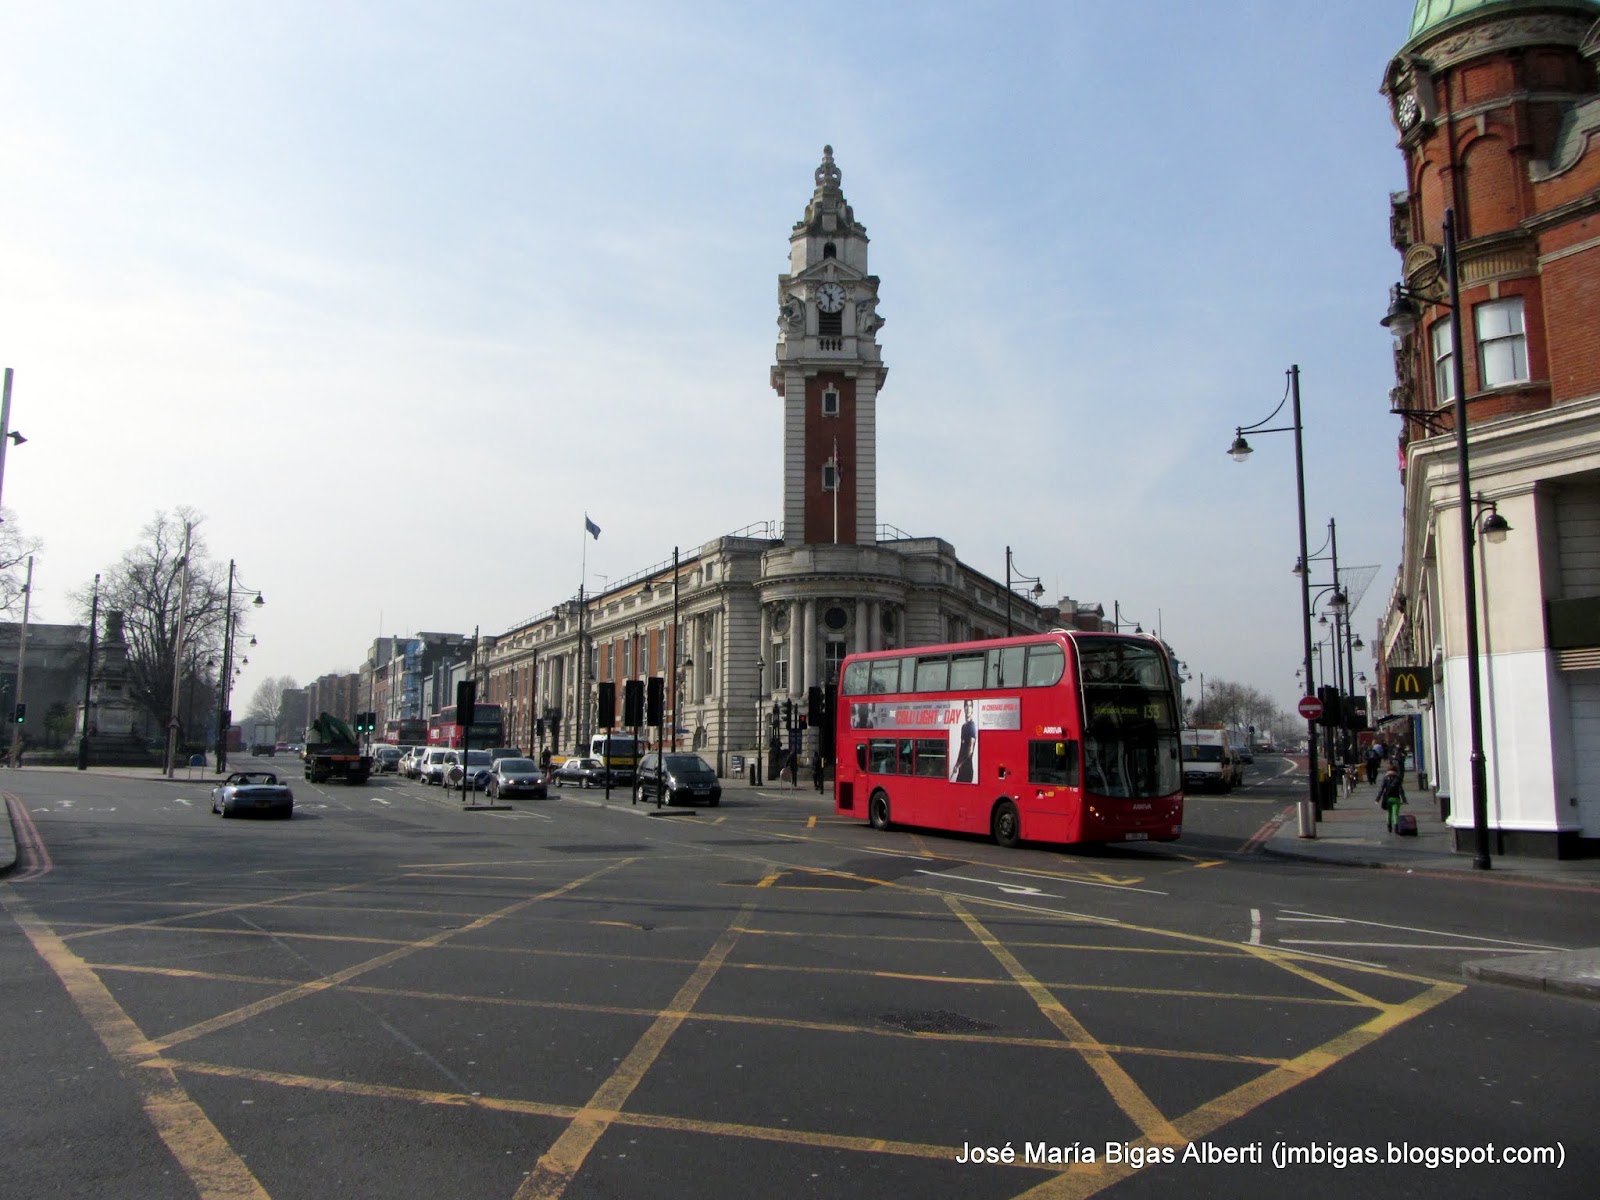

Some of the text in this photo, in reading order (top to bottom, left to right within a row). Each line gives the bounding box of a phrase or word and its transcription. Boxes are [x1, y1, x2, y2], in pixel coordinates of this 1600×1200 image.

[916, 709, 939, 725] LIGHT
[944, 709, 961, 725] DAY
[1143, 704, 1161, 719] 133
[1043, 726, 1062, 734] ARRIVA
